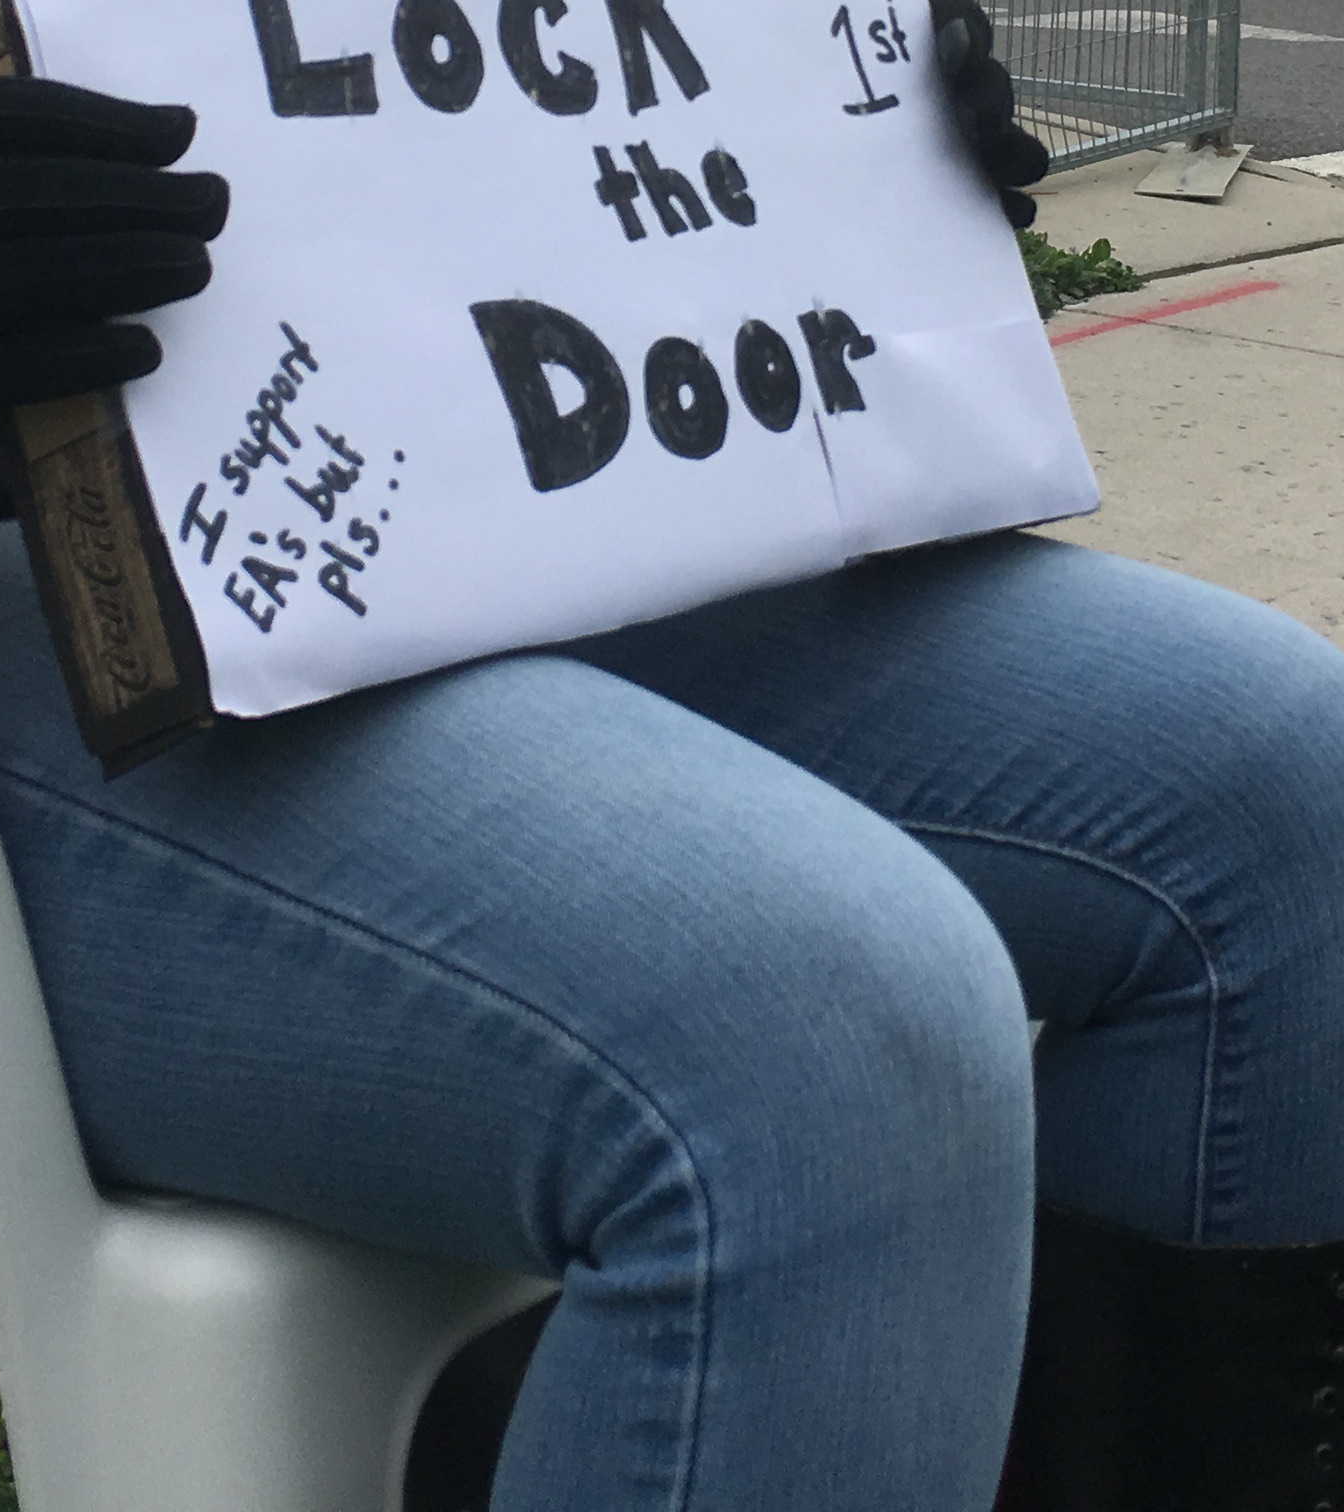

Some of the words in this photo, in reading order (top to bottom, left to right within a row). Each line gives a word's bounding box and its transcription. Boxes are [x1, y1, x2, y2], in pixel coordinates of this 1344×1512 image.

[830, 3, 911, 116] 1st
[593, 140, 757, 243] the
[178, 481, 229, 567] I
[219, 320, 320, 496] support
[469, 299, 878, 493] Door
[223, 527, 308, 635] EA's
[283, 423, 366, 524] but
